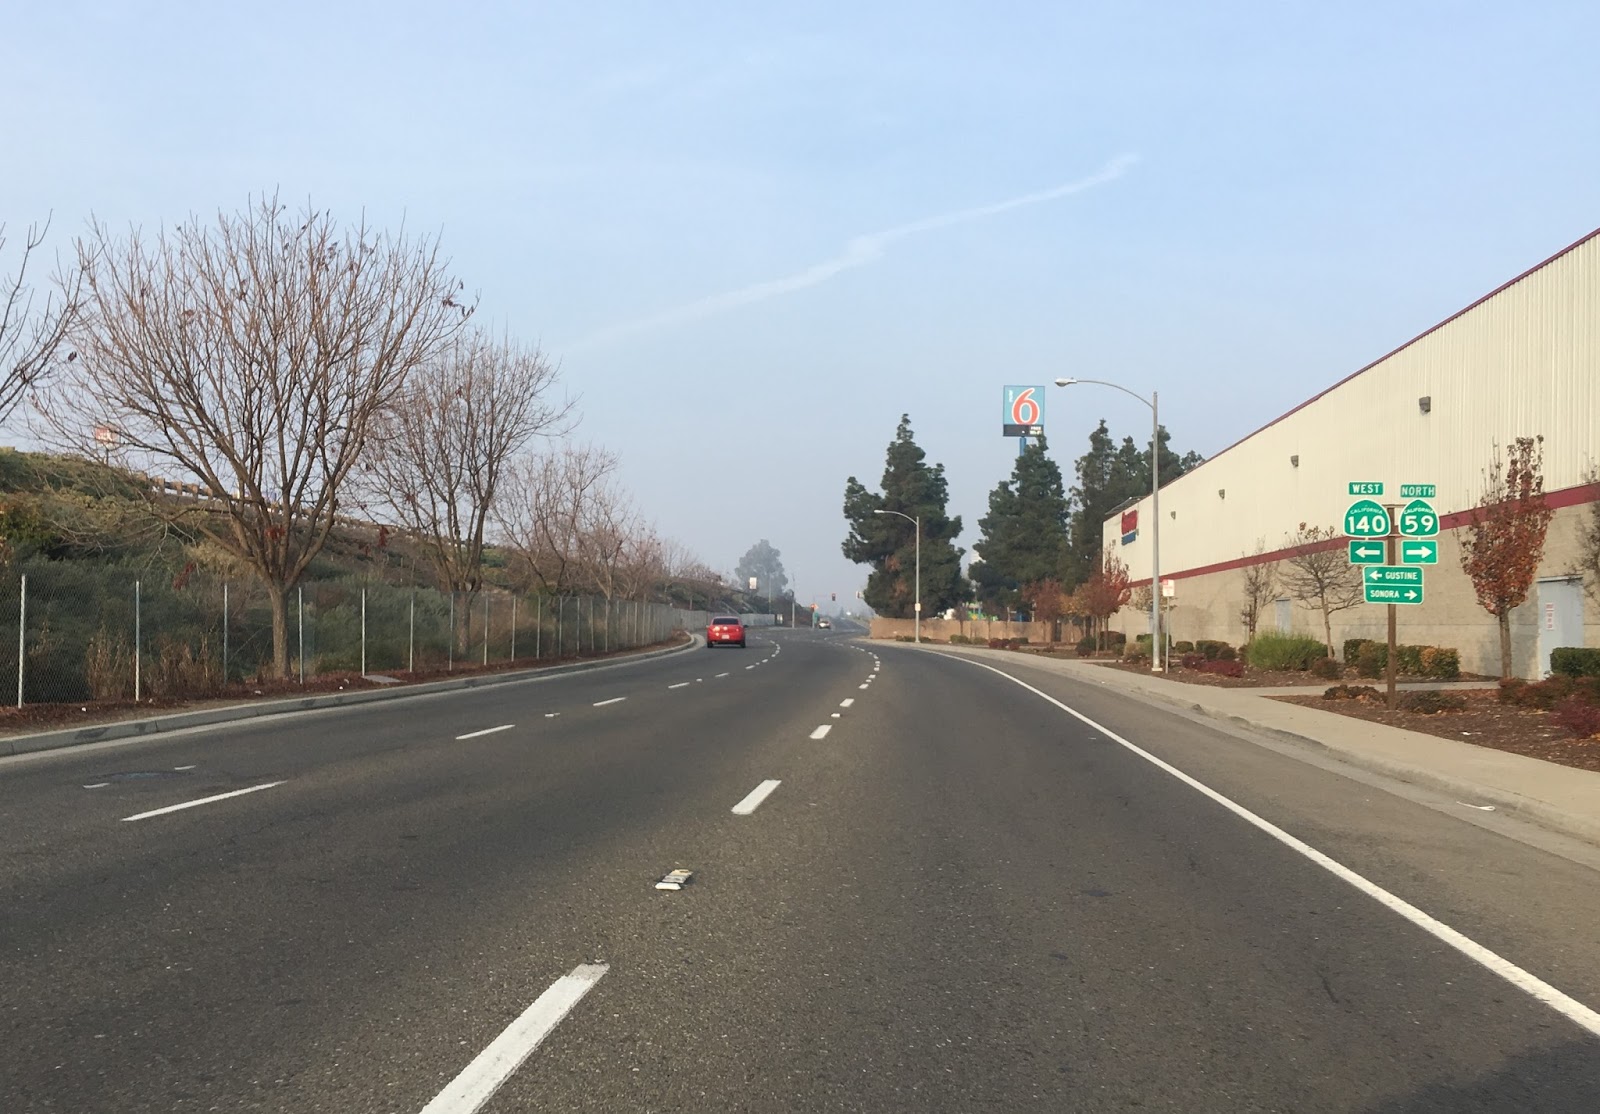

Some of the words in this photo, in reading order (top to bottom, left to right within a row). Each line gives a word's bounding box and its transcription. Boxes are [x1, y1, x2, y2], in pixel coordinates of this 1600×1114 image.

[1012, 388, 1040, 425] 6
[1352, 484, 1380, 494] WEST
[1401, 486, 1435, 496] NORTH
[1350, 507, 1383, 515] CALIFORNIA
[1403, 507, 1434, 515] CALIFORNIA
[1348, 515, 1386, 533] 140
[1405, 515, 1434, 533] 59
[1385, 571, 1418, 580] GUSTINE
[1370, 589, 1400, 598] SONORA
